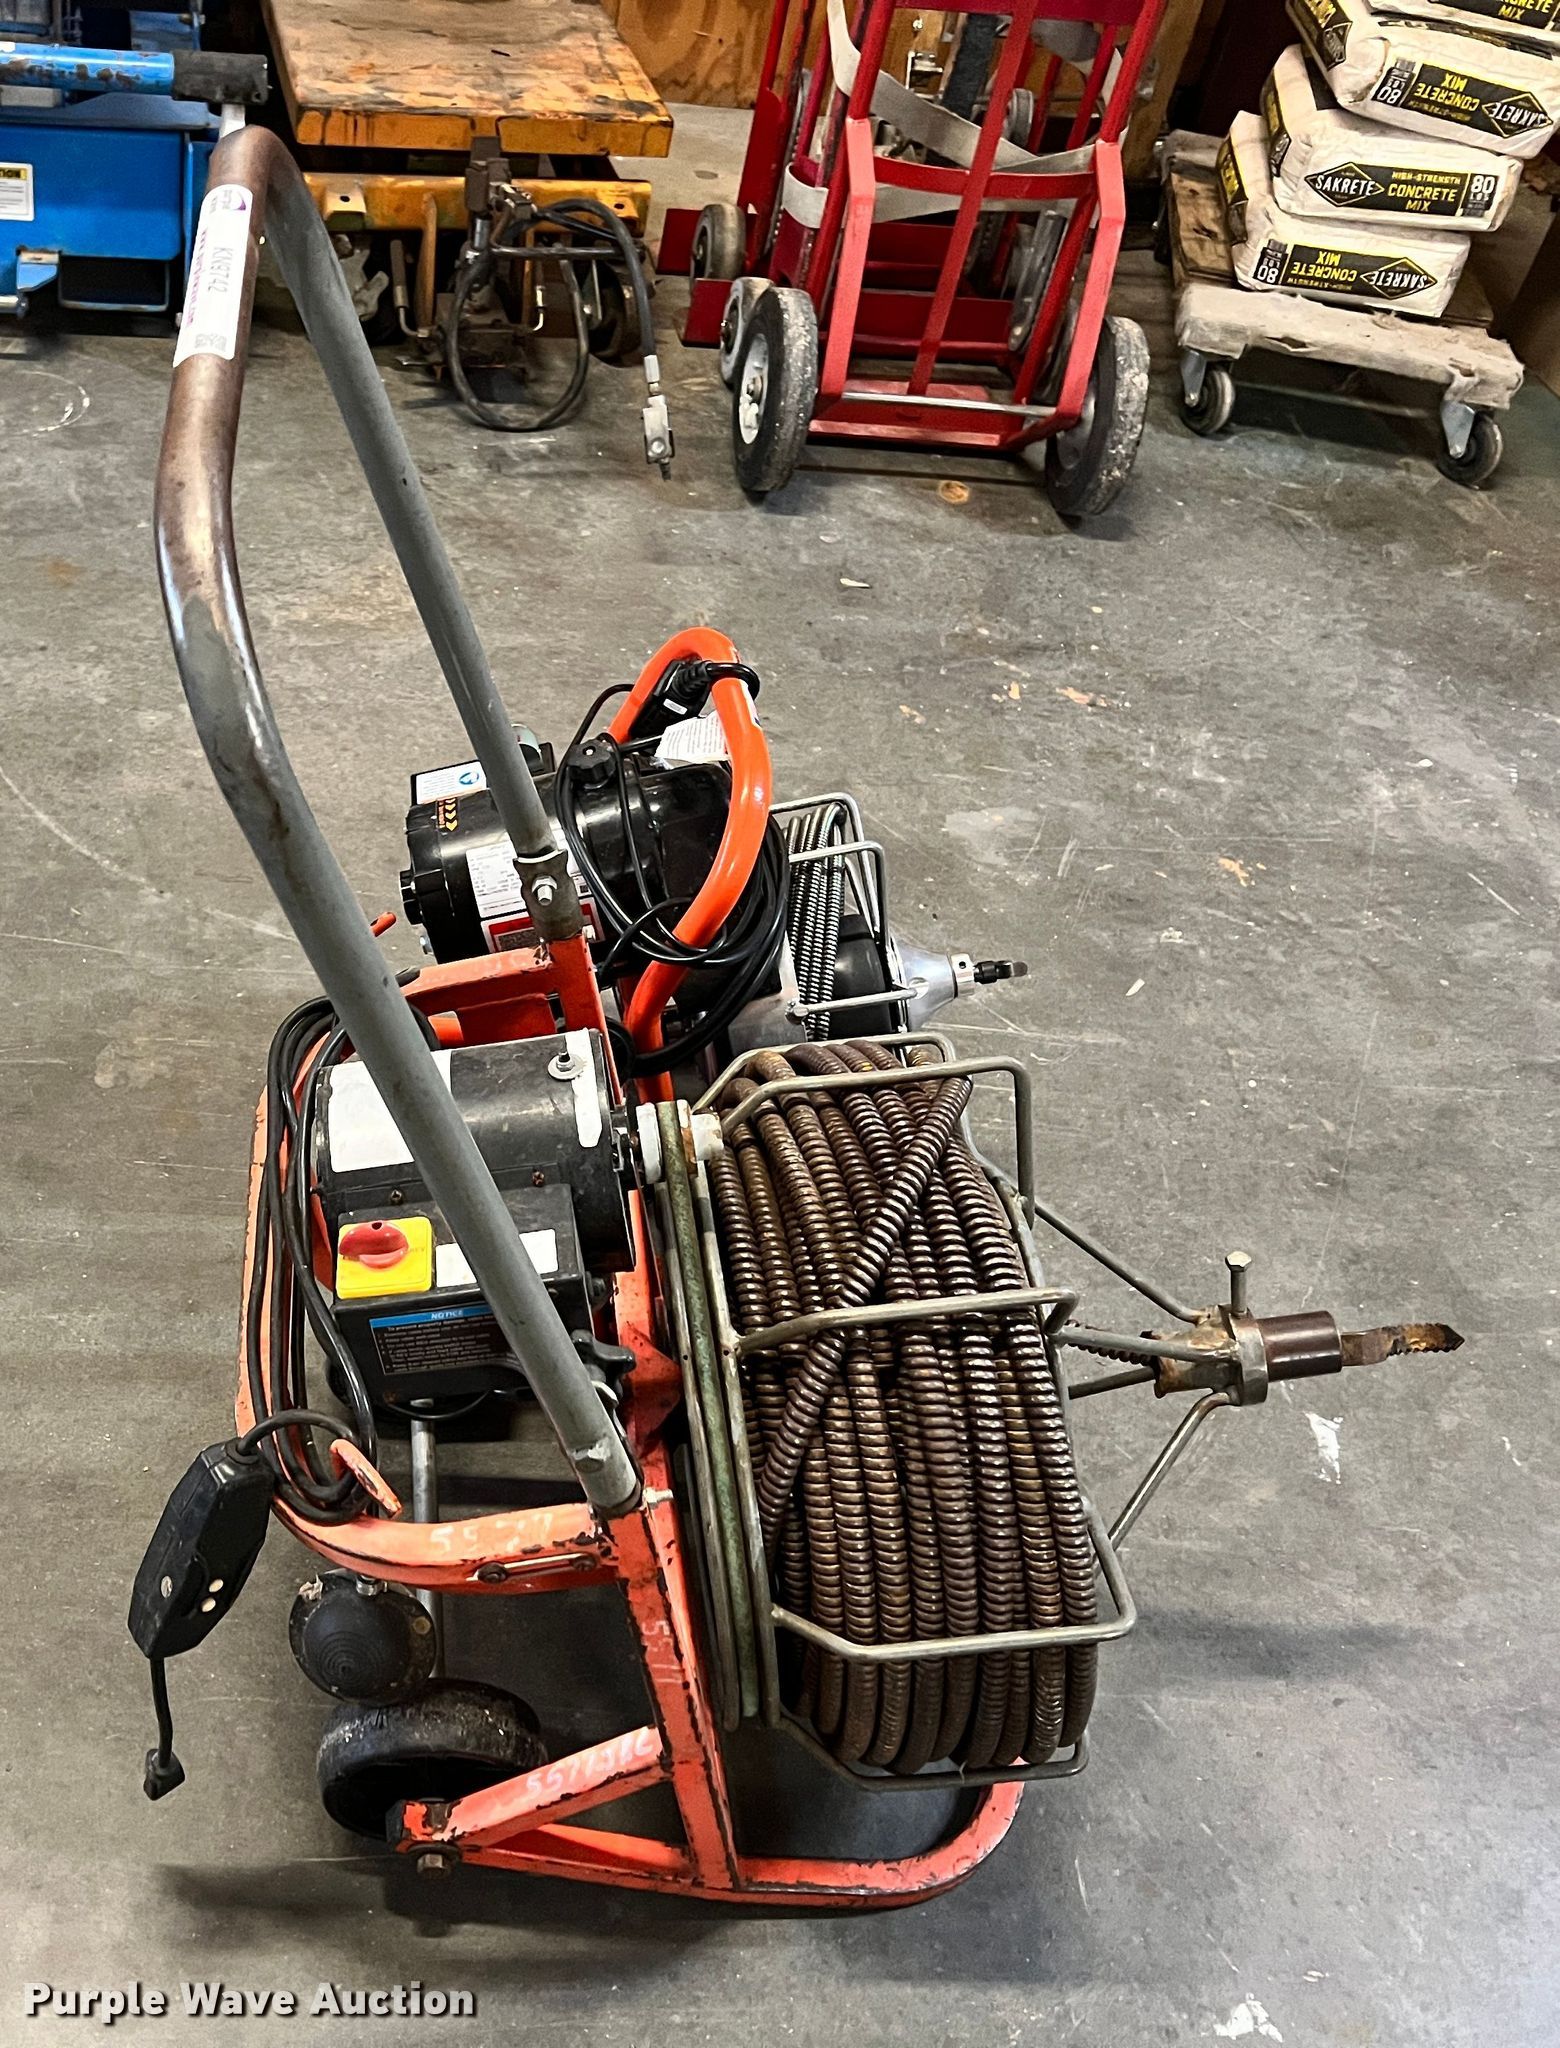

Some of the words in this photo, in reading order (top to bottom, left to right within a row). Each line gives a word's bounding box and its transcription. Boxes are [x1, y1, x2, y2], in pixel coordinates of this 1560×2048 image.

[1498, 5, 1525, 20] MIX
[1441, 73, 1468, 92] MIX
[1377, 86, 1402, 104] 80
[1414, 83, 1480, 111] CONCRETE
[1489, 102, 1545, 126] SAKRETE
[1315, 174, 1374, 196] SAKRETE
[1388, 184, 1457, 202] CONCRETE
[1470, 175, 1495, 194] 80
[1405, 200, 1432, 212] MIX
[1315, 251, 1341, 265] MIX
[208, 247, 233, 293] KN9742
[1257, 265, 1278, 284] 80
[1291, 262, 1358, 282] CONCRETE
[1370, 271, 1428, 289] SAKRETE
[431, 1310, 463, 1320] NOTICE
